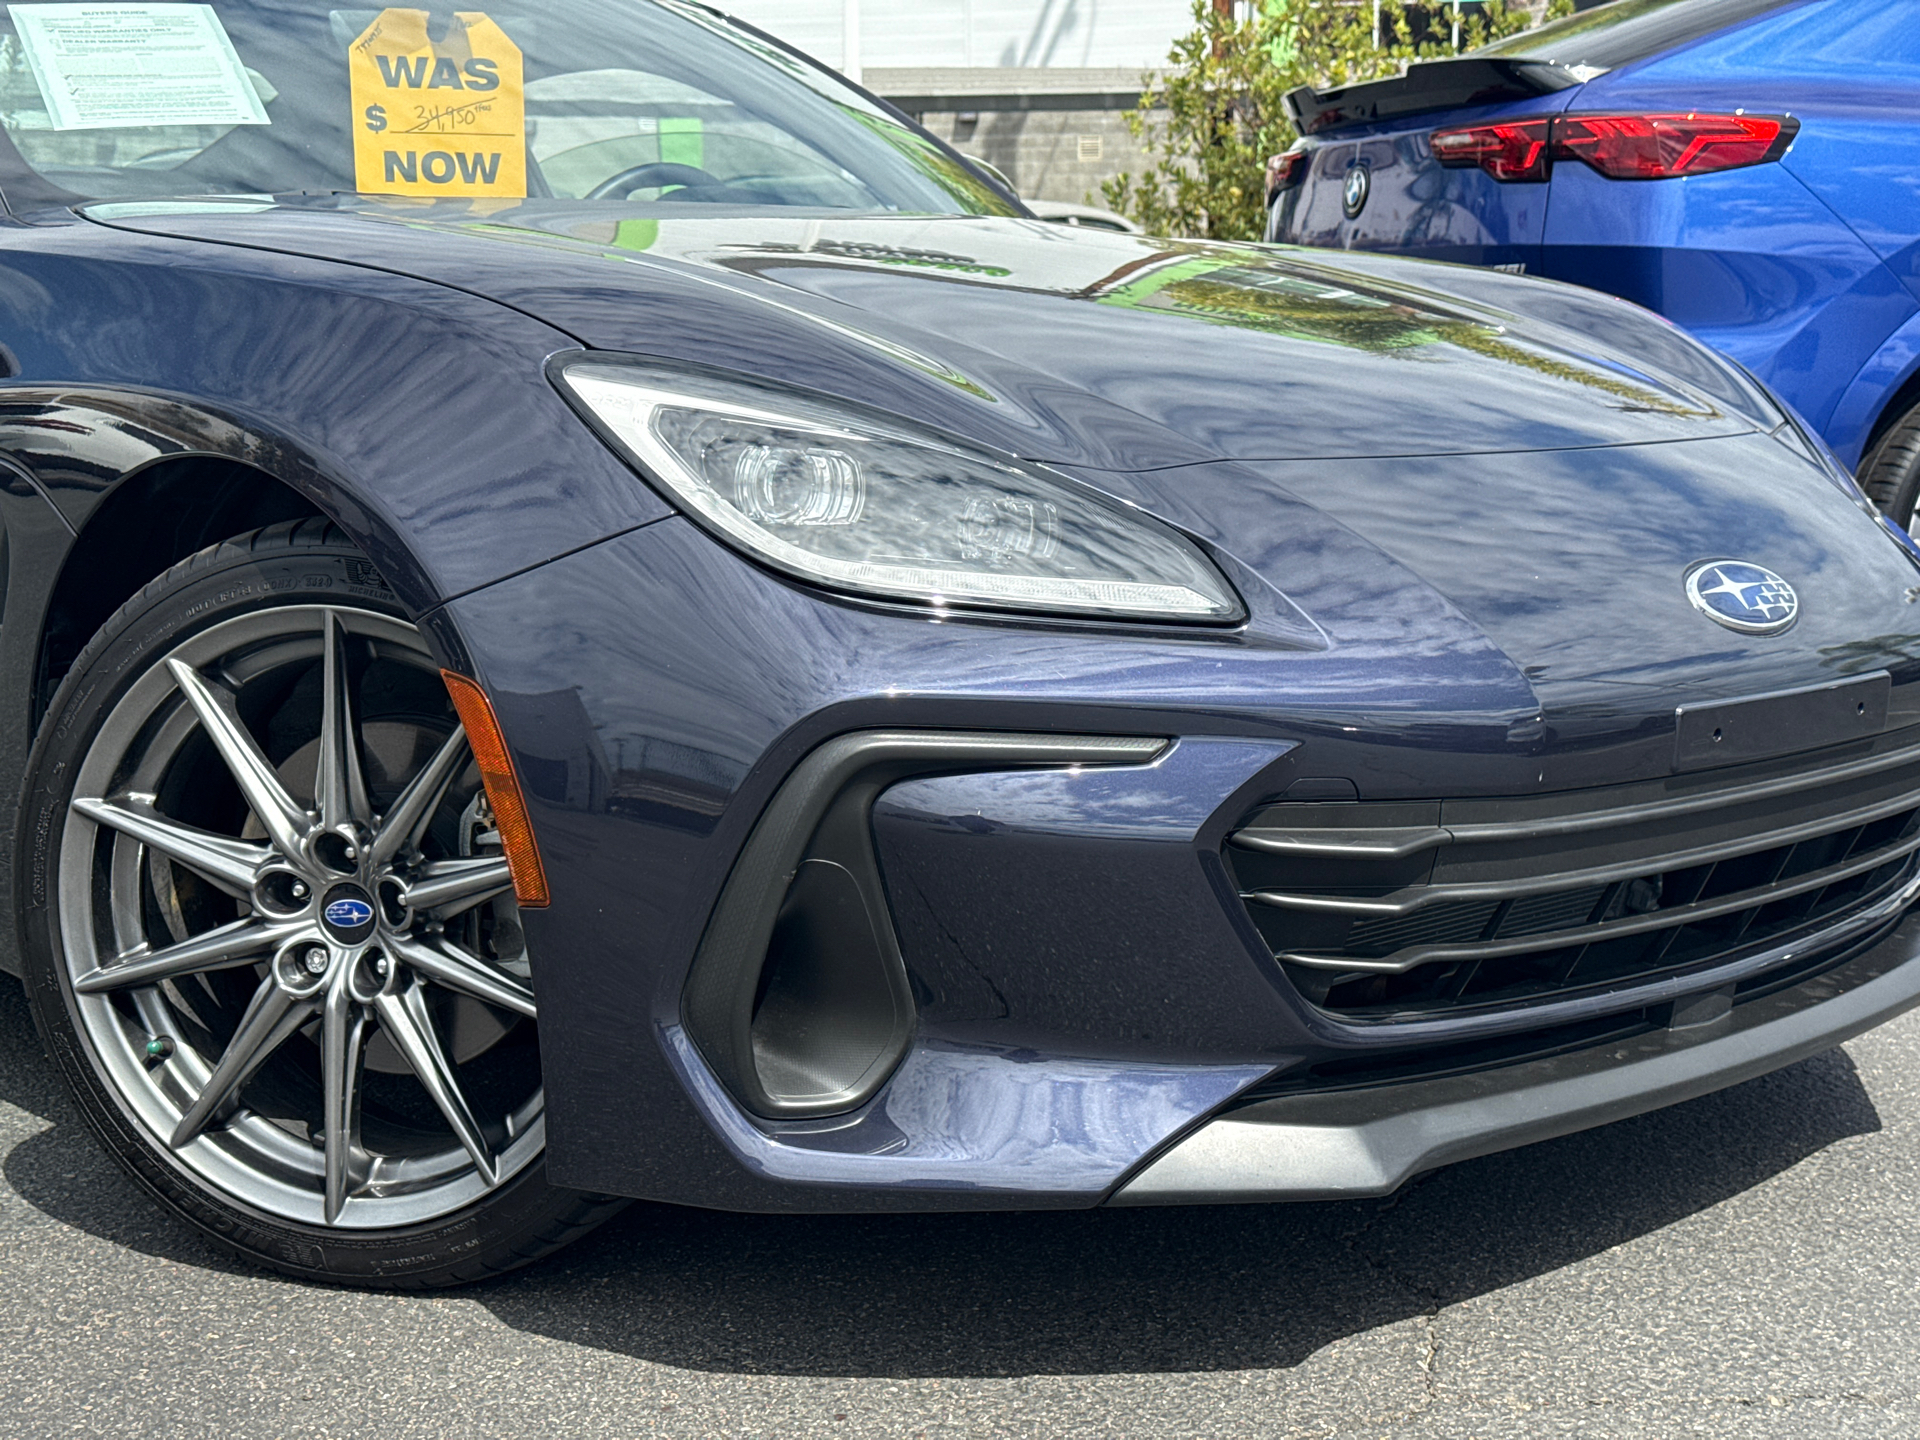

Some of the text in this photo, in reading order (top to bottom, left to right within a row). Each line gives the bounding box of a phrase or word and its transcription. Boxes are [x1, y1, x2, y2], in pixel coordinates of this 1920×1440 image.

[375, 55, 500, 92] WAS
[365, 103, 388, 134] $
[383, 150, 502, 184] NOW
[348, 585, 389, 600] MICHELIN
[135, 1157, 273, 1249] MICHELIN
